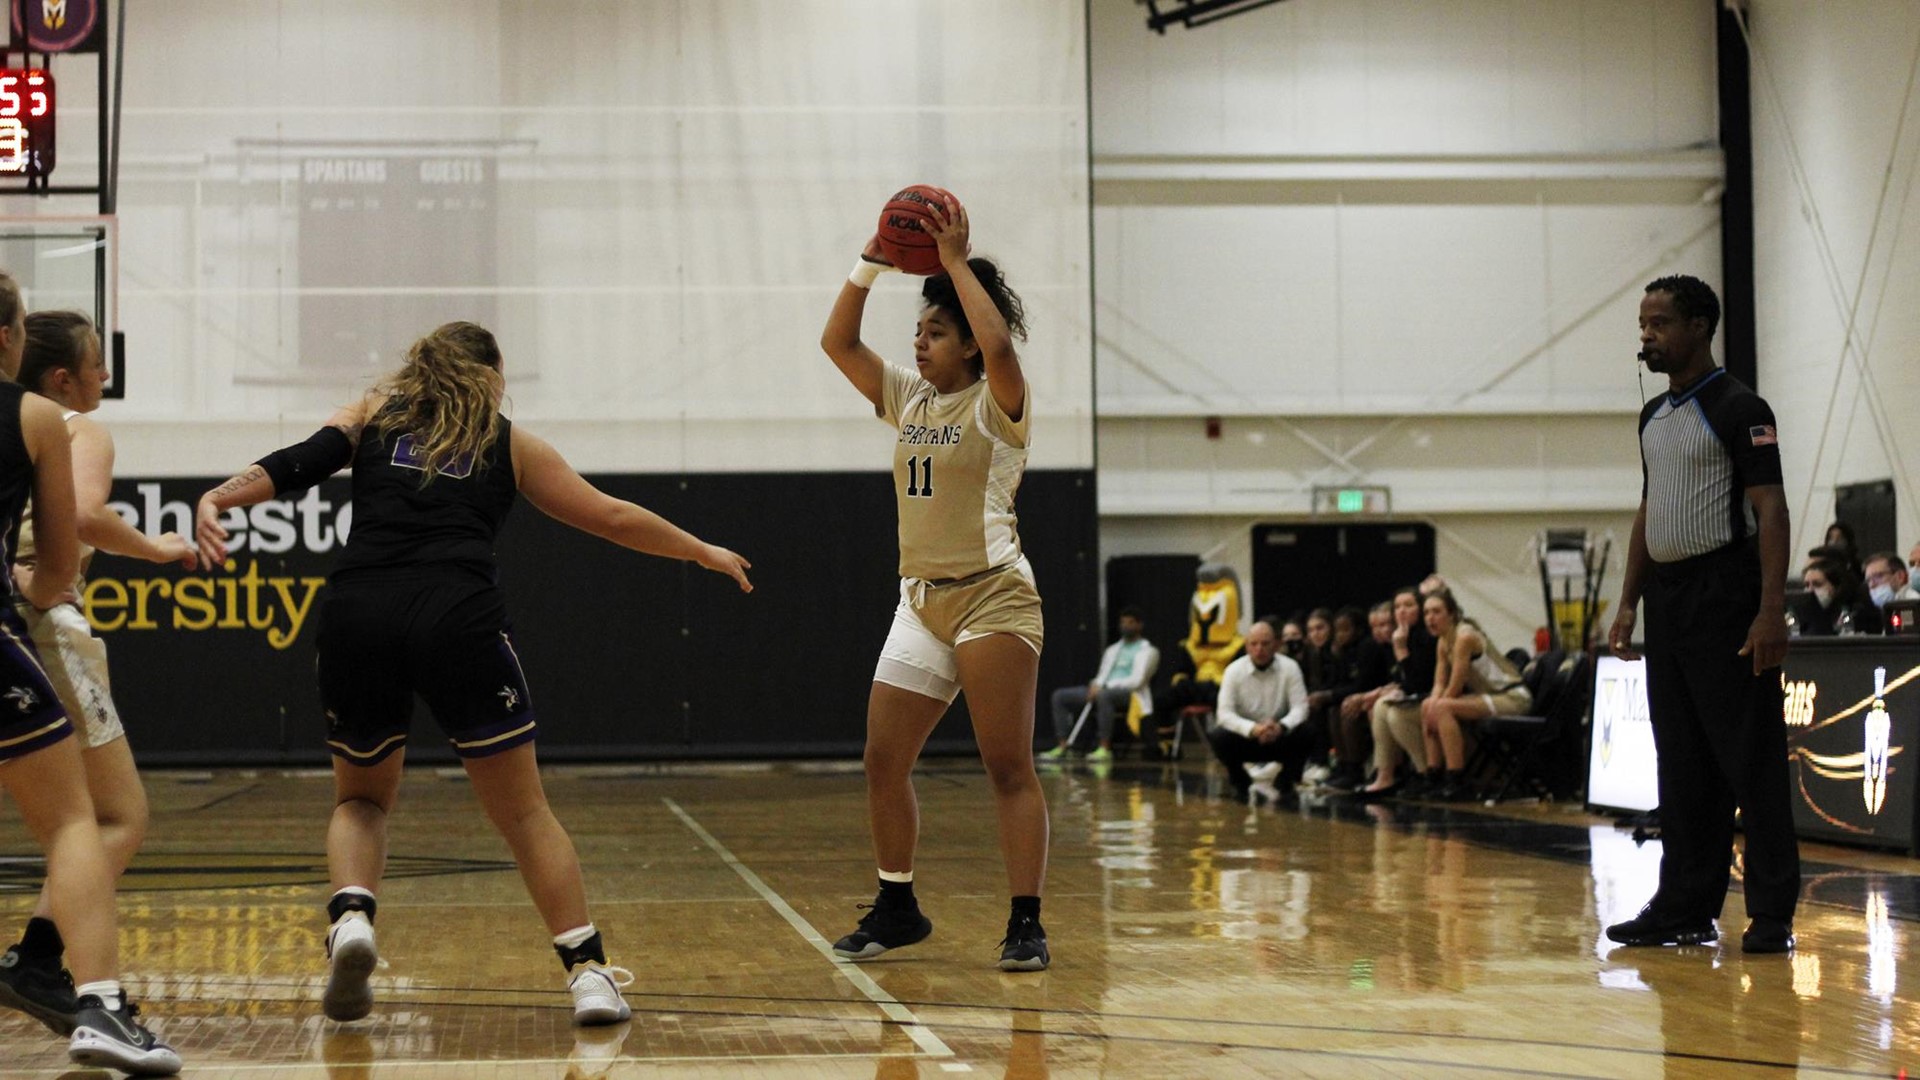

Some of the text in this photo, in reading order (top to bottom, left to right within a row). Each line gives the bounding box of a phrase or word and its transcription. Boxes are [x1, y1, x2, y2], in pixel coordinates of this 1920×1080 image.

[304, 160, 482, 183] SPARTANS GUESTS
[899, 424, 962, 445] SPARTANS
[907, 455, 933, 498] 11
[82, 558, 326, 649] ersity
[1622, 677, 1651, 722] Ma
